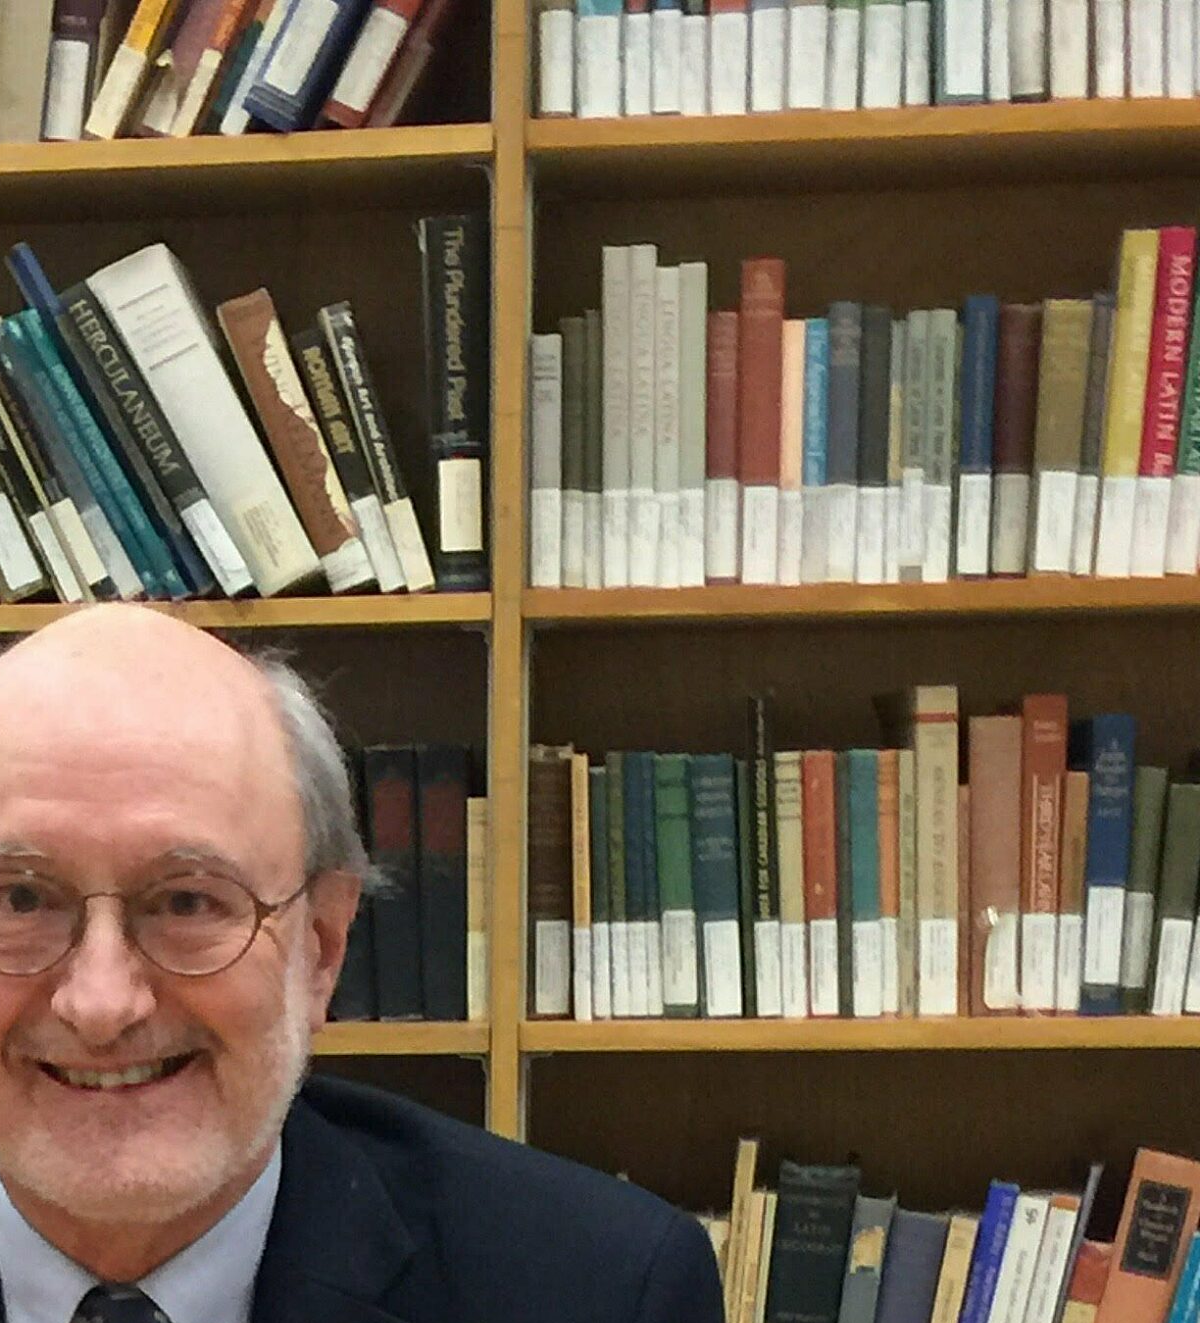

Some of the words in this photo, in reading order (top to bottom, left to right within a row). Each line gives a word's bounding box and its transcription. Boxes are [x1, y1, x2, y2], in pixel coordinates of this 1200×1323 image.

[443, 226, 465, 267] The
[444, 269, 466, 371] Plundered
[1165, 254, 1192, 362] MODERN
[68, 299, 181, 477] HERCULANEUM
[302, 345, 342, 419] ROMAN
[448, 375, 468, 421] Past
[1156, 371, 1180, 441] LATIN
